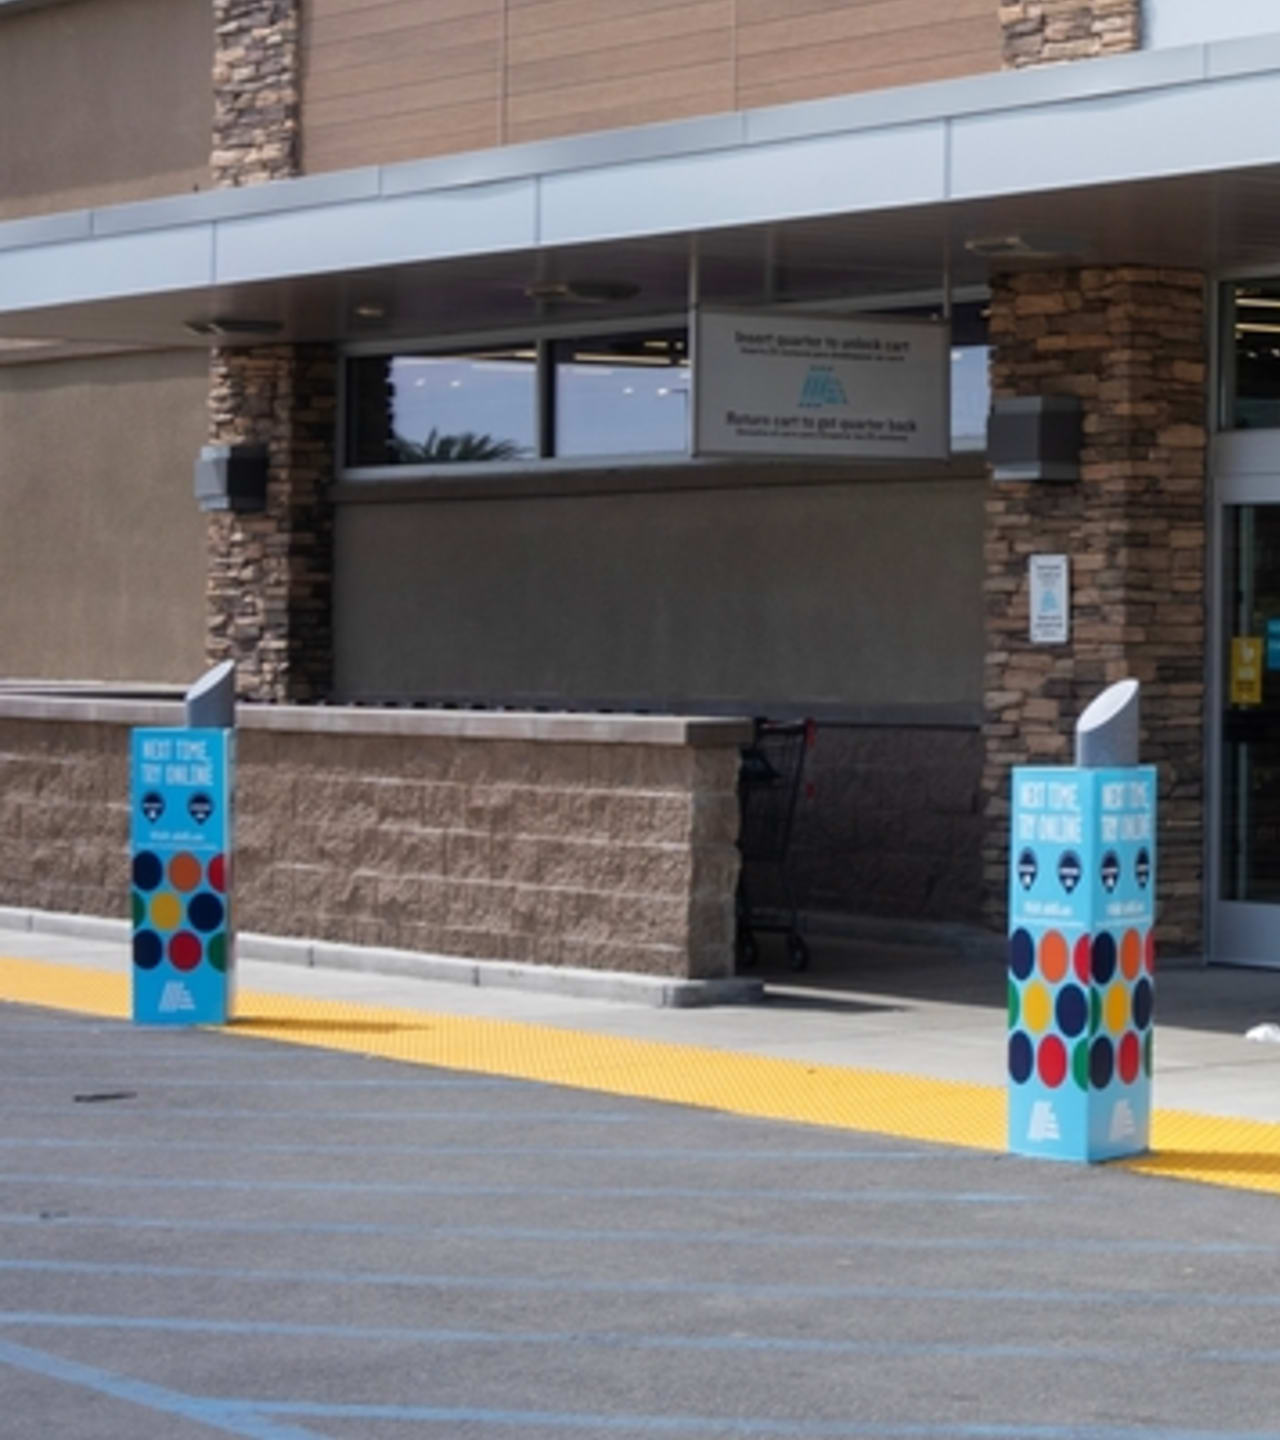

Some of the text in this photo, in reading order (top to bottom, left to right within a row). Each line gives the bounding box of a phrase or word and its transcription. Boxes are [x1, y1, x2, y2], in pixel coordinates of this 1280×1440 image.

[777, 334, 822, 348] quarter
[825, 336, 838, 348] to
[885, 340, 910, 353] cart
[726, 411, 917, 434] Return cart to get quarter back
